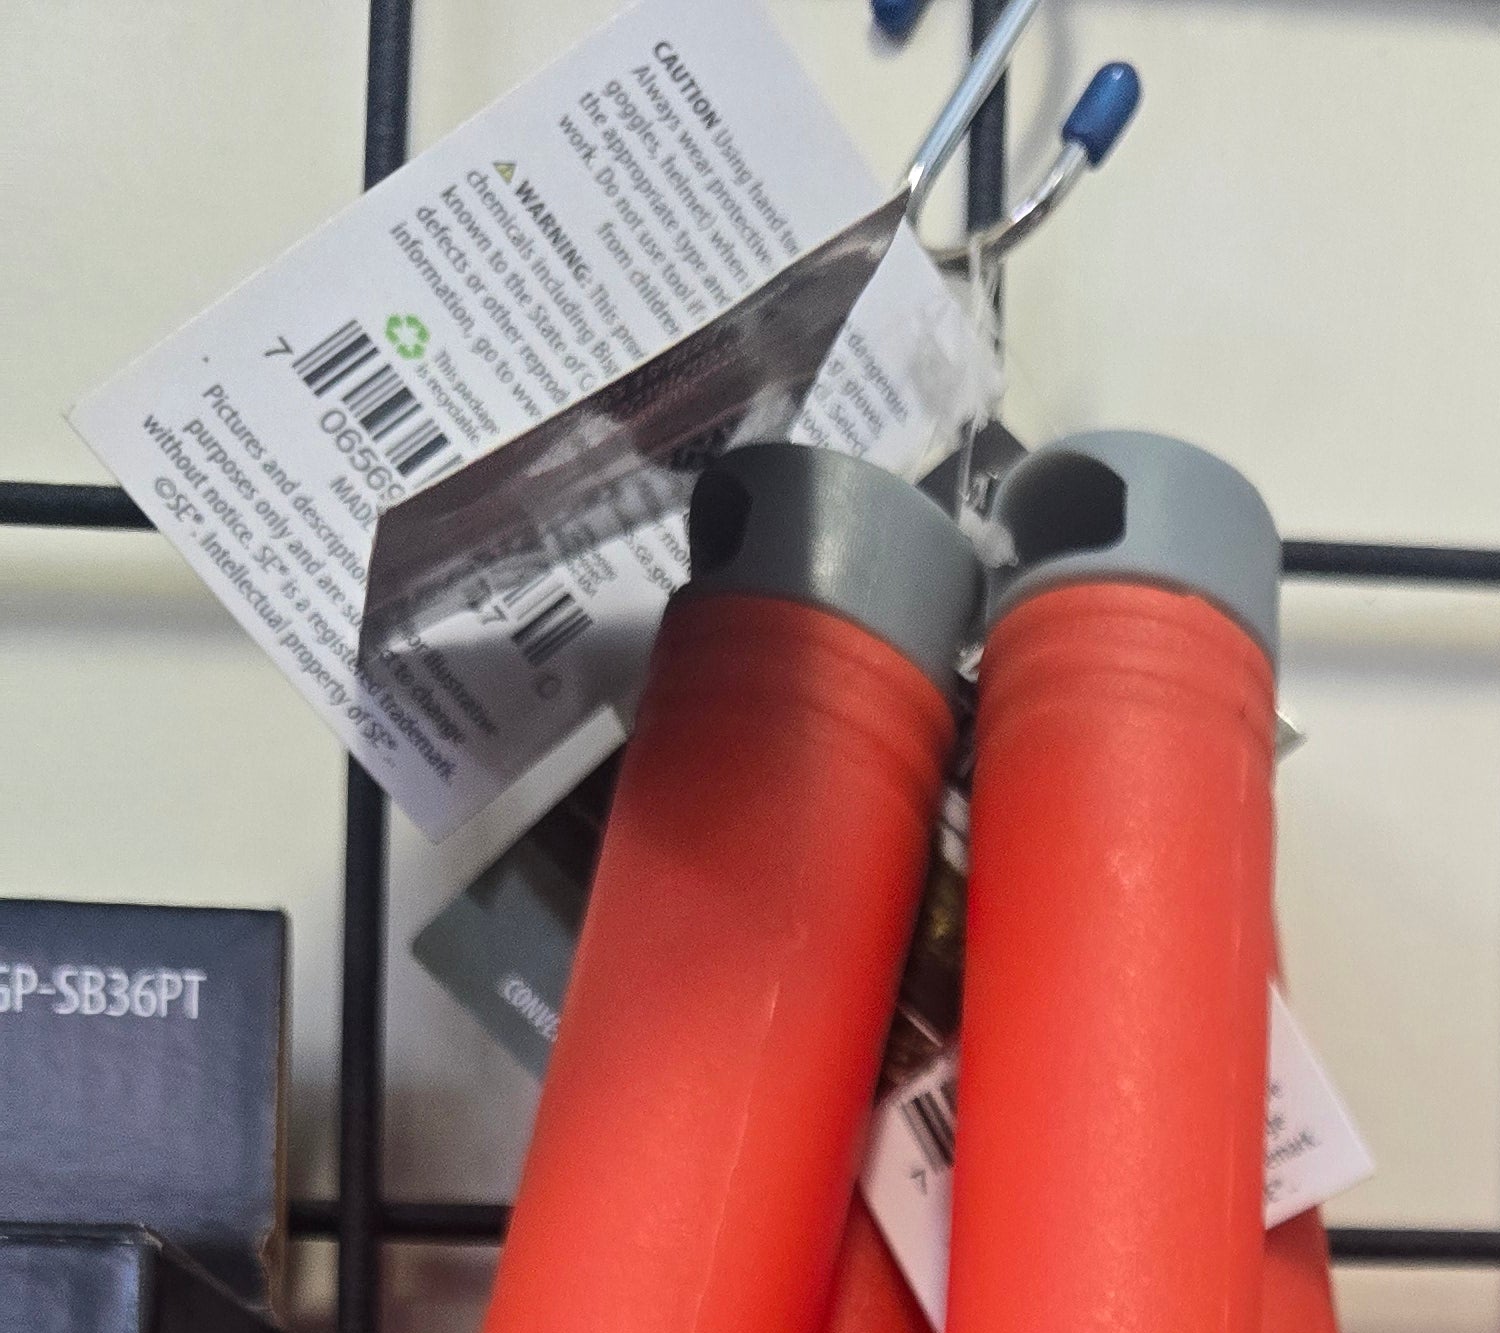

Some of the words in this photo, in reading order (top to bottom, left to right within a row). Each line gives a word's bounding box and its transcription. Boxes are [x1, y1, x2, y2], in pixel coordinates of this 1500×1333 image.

[556, 111, 603, 171] work.
[593, 166, 624, 200] Do
[613, 195, 645, 232] not
[636, 230, 666, 266] use
[659, 261, 695, 303] tool
[577, 89, 611, 128] the
[599, 124, 681, 236] appropriate
[668, 230, 710, 278] type
[599, 75, 669, 163] goggles,
[657, 152, 719, 232] helmet)
[707, 229, 750, 282] when
[627, 61, 686, 135] Always
[675, 129, 716, 179] wear
[704, 174, 775, 269] protective
[650, 38, 721, 132] CAUTION
[707, 130, 756, 188] Using
[746, 182, 788, 233] hand
[387, 221, 483, 339] information,
[467, 335, 498, 368] go
[491, 360, 516, 386] to
[413, 202, 474, 275] defects
[463, 272, 486, 297] or
[478, 292, 526, 347] other
[438, 184, 497, 253] known
[485, 250, 511, 276] to
[501, 270, 535, 309] the
[525, 305, 568, 354] State
[561, 349, 586, 375] of
[464, 166, 541, 261] chemicals
[526, 256, 600, 346] including
[512, 180, 597, 290] WARNING:
[585, 283, 623, 326] This
[595, 220, 637, 271] from
[201, 383, 273, 461] Pictures
[260, 457, 299, 497] and
[261, 335, 294, 366] 7
[414, 362, 433, 381] is
[430, 347, 462, 384] This
[140, 412, 212, 491] without
[199, 485, 260, 552] notice.
[278, 578, 302, 602] is
[292, 597, 310, 614] a
[302, 610, 384, 698] registered
[181, 417, 259, 504] purposes
[249, 497, 294, 543] only
[285, 534, 327, 577] and
[315, 573, 347, 606] are
[198, 531, 290, 636] Intellectual
[278, 634, 349, 712] property
[344, 702, 370, 728] of
